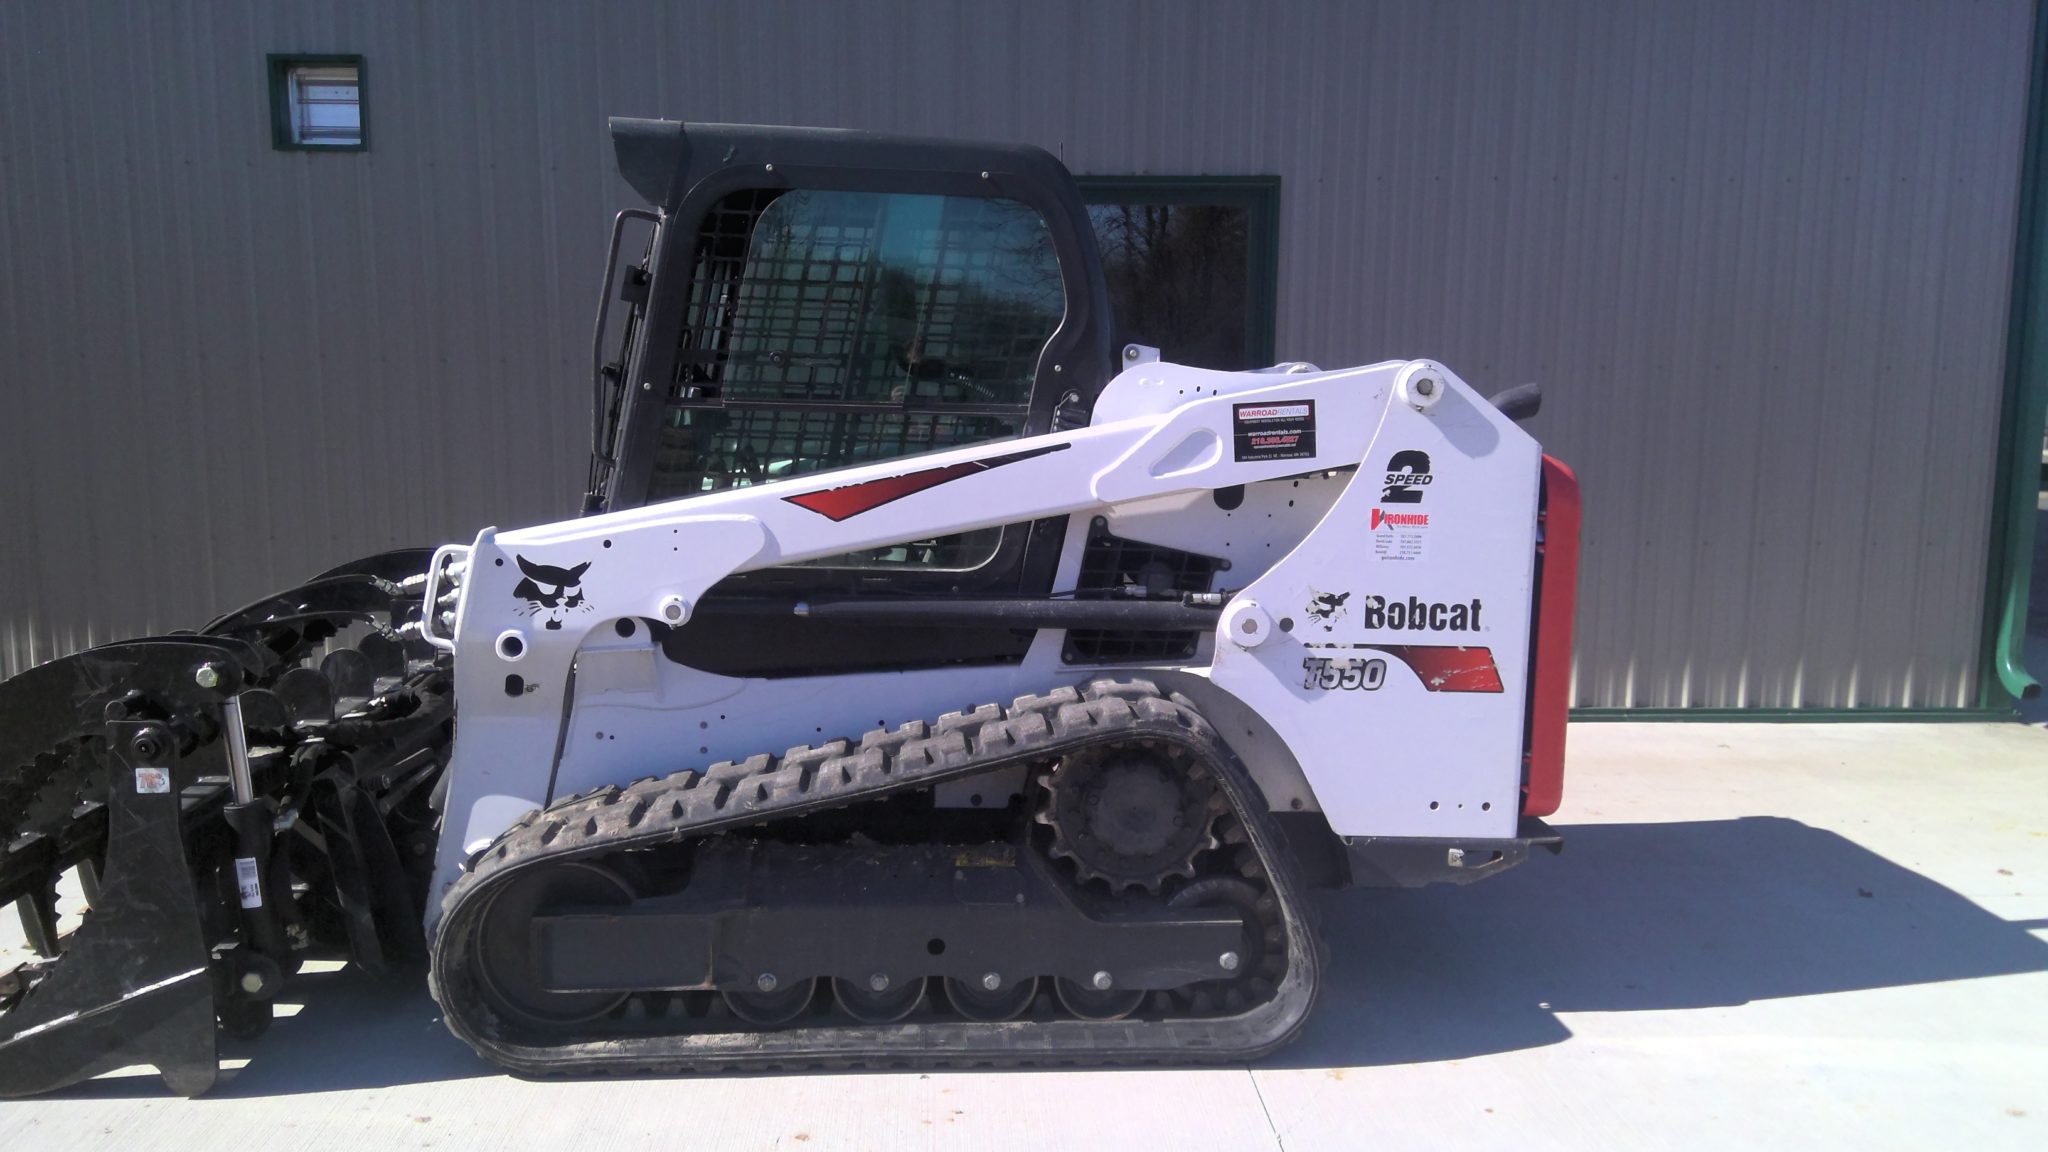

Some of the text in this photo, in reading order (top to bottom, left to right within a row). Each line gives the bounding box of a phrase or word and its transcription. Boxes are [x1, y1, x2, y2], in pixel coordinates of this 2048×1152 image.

[1248, 429, 1301, 437] warroadrentals.com
[1380, 450, 1430, 503] 2
[1384, 474, 1433, 485] SPEED
[1384, 513, 1429, 525] IRONHIDE
[1364, 595, 1482, 631] Bobcat
[1304, 657, 1387, 691] T550
